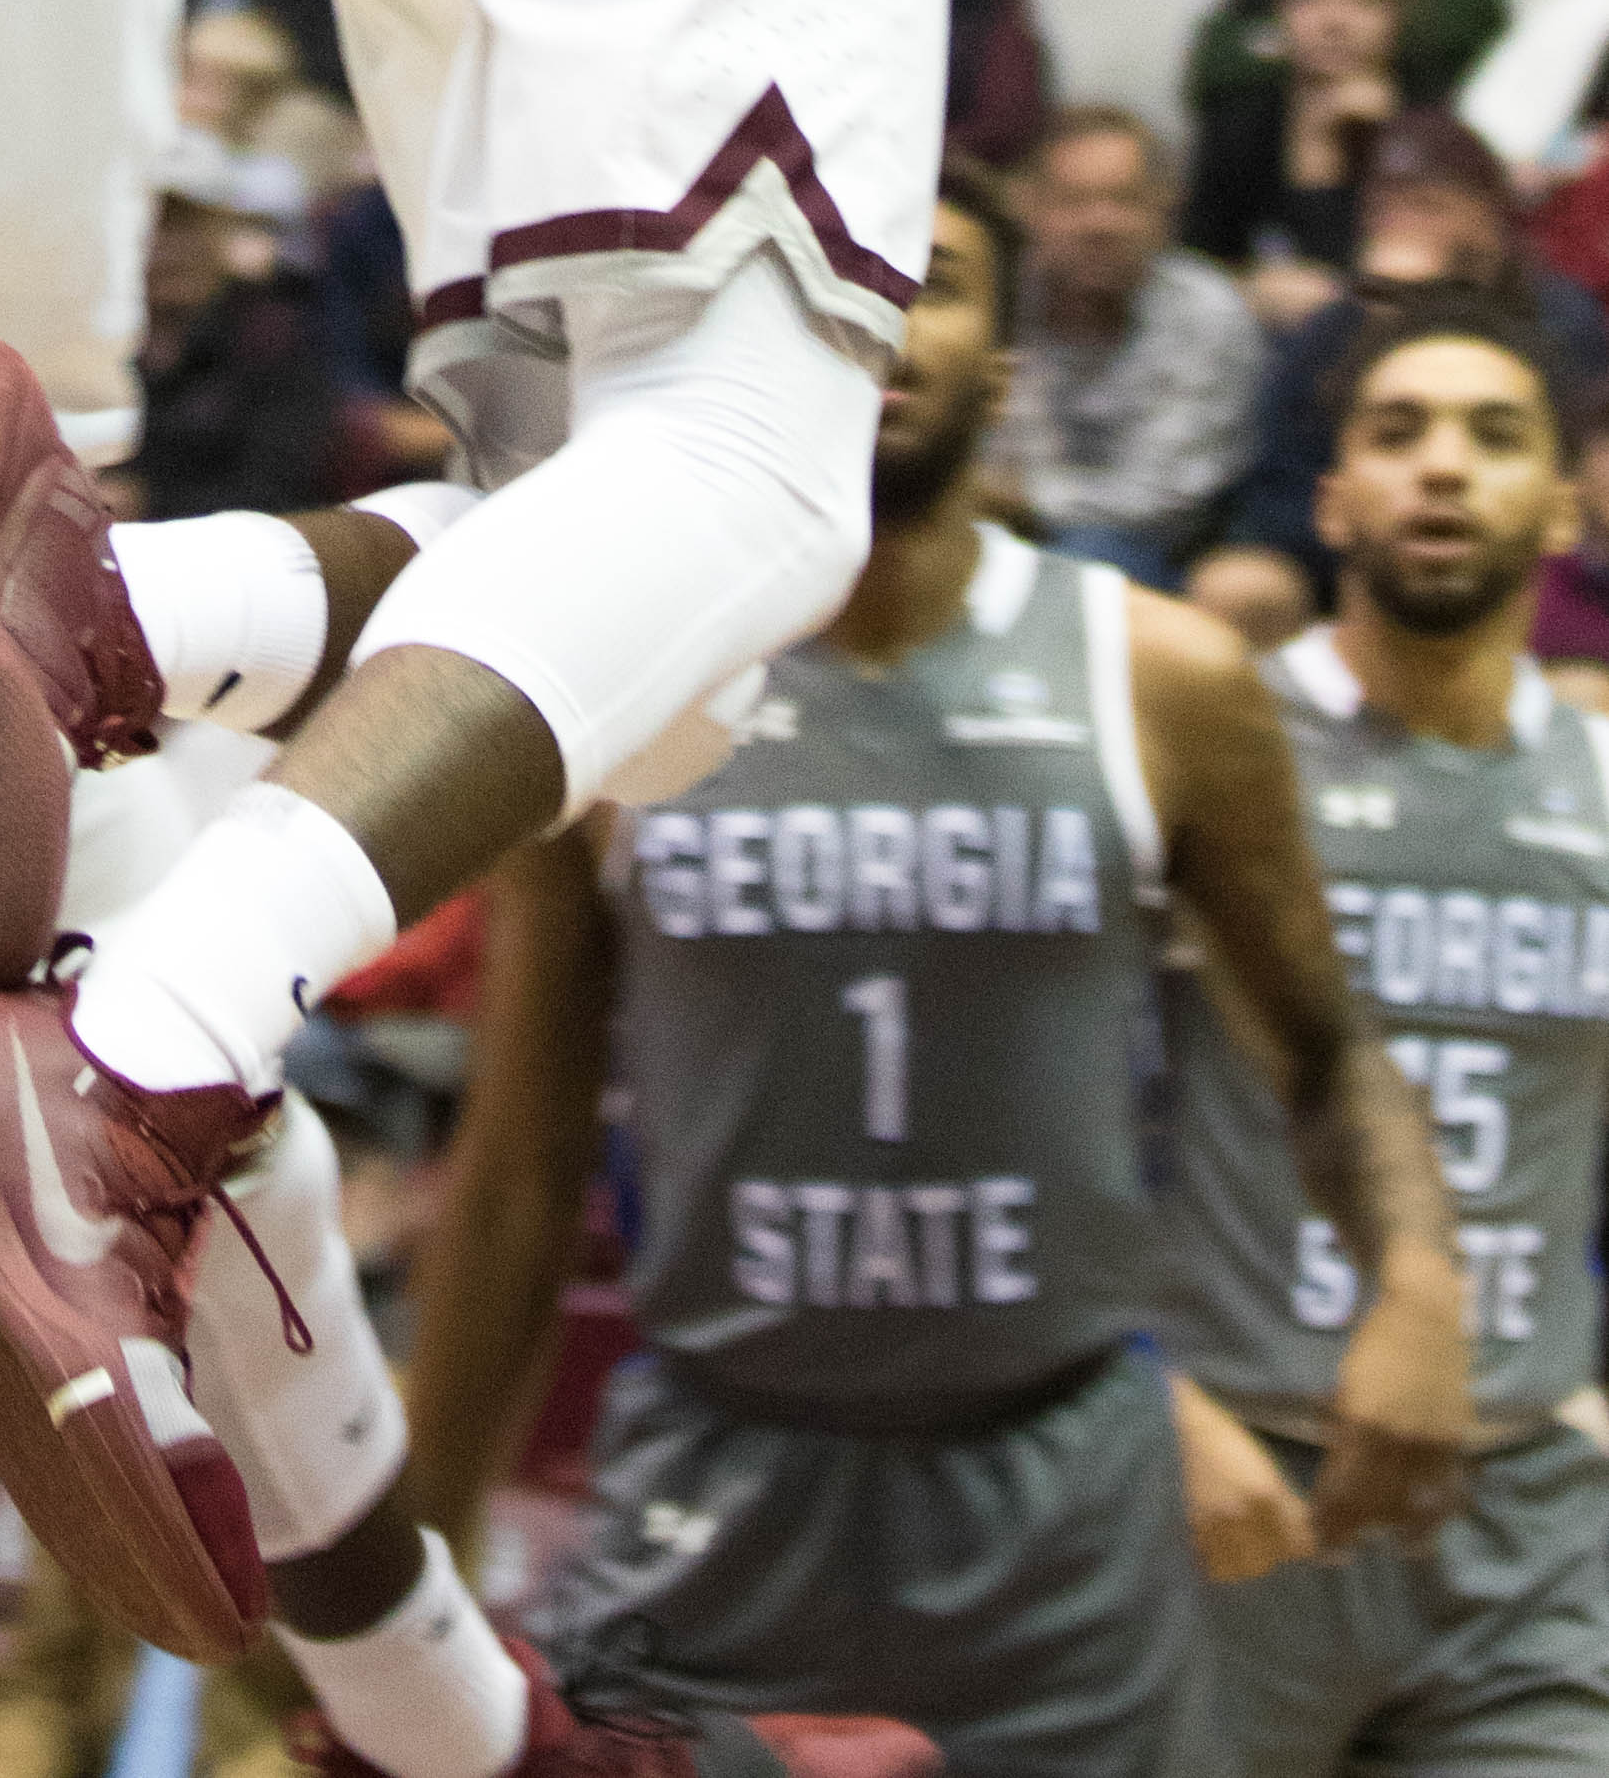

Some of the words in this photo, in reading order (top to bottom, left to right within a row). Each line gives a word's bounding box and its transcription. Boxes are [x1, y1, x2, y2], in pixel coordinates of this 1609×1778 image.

[636, 804, 1100, 938] GEORGIA
[841, 975, 909, 1144] 1
[730, 1177, 1039, 1309] STATE
[1290, 1218, 1545, 1337] STE
